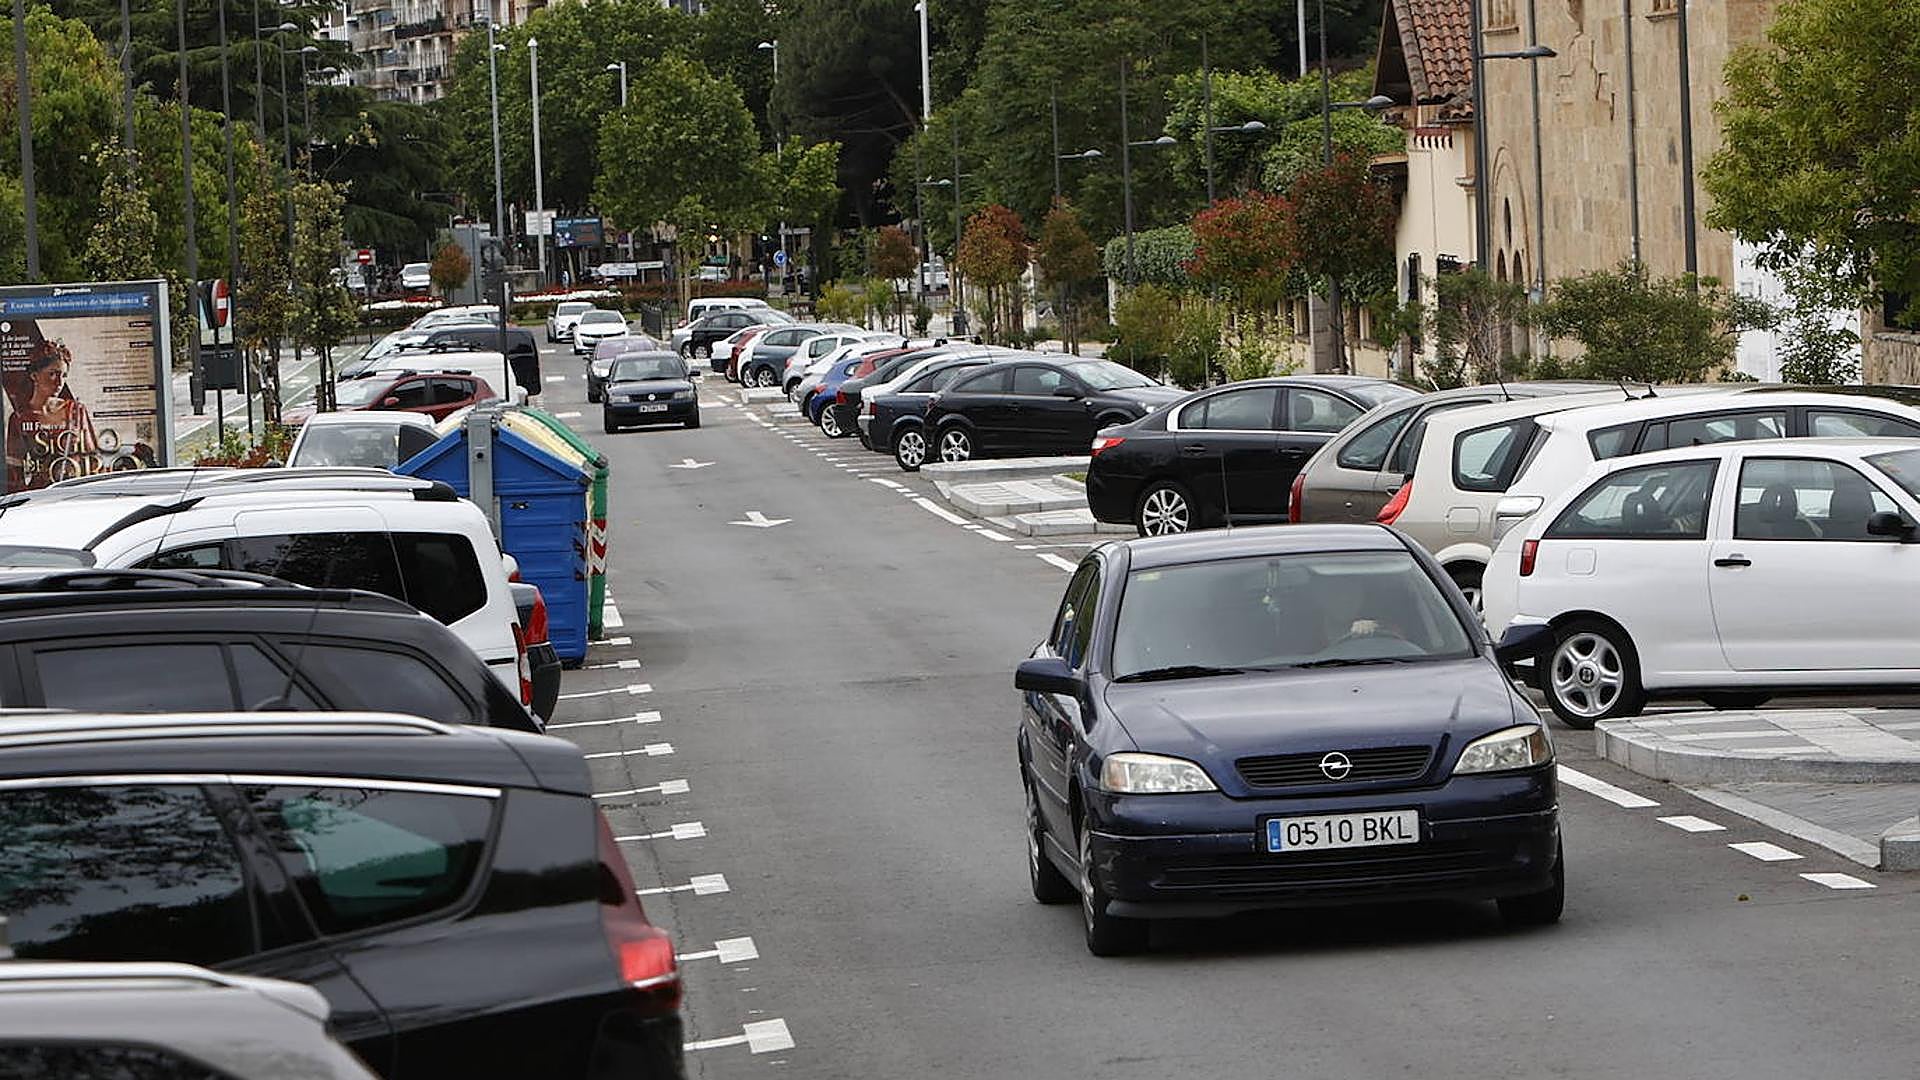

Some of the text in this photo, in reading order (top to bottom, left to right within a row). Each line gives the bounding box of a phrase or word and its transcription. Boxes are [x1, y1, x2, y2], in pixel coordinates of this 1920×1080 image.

[99, 296, 139, 305] Salamanca
[1287, 815, 1413, 846] 0510 BKL
